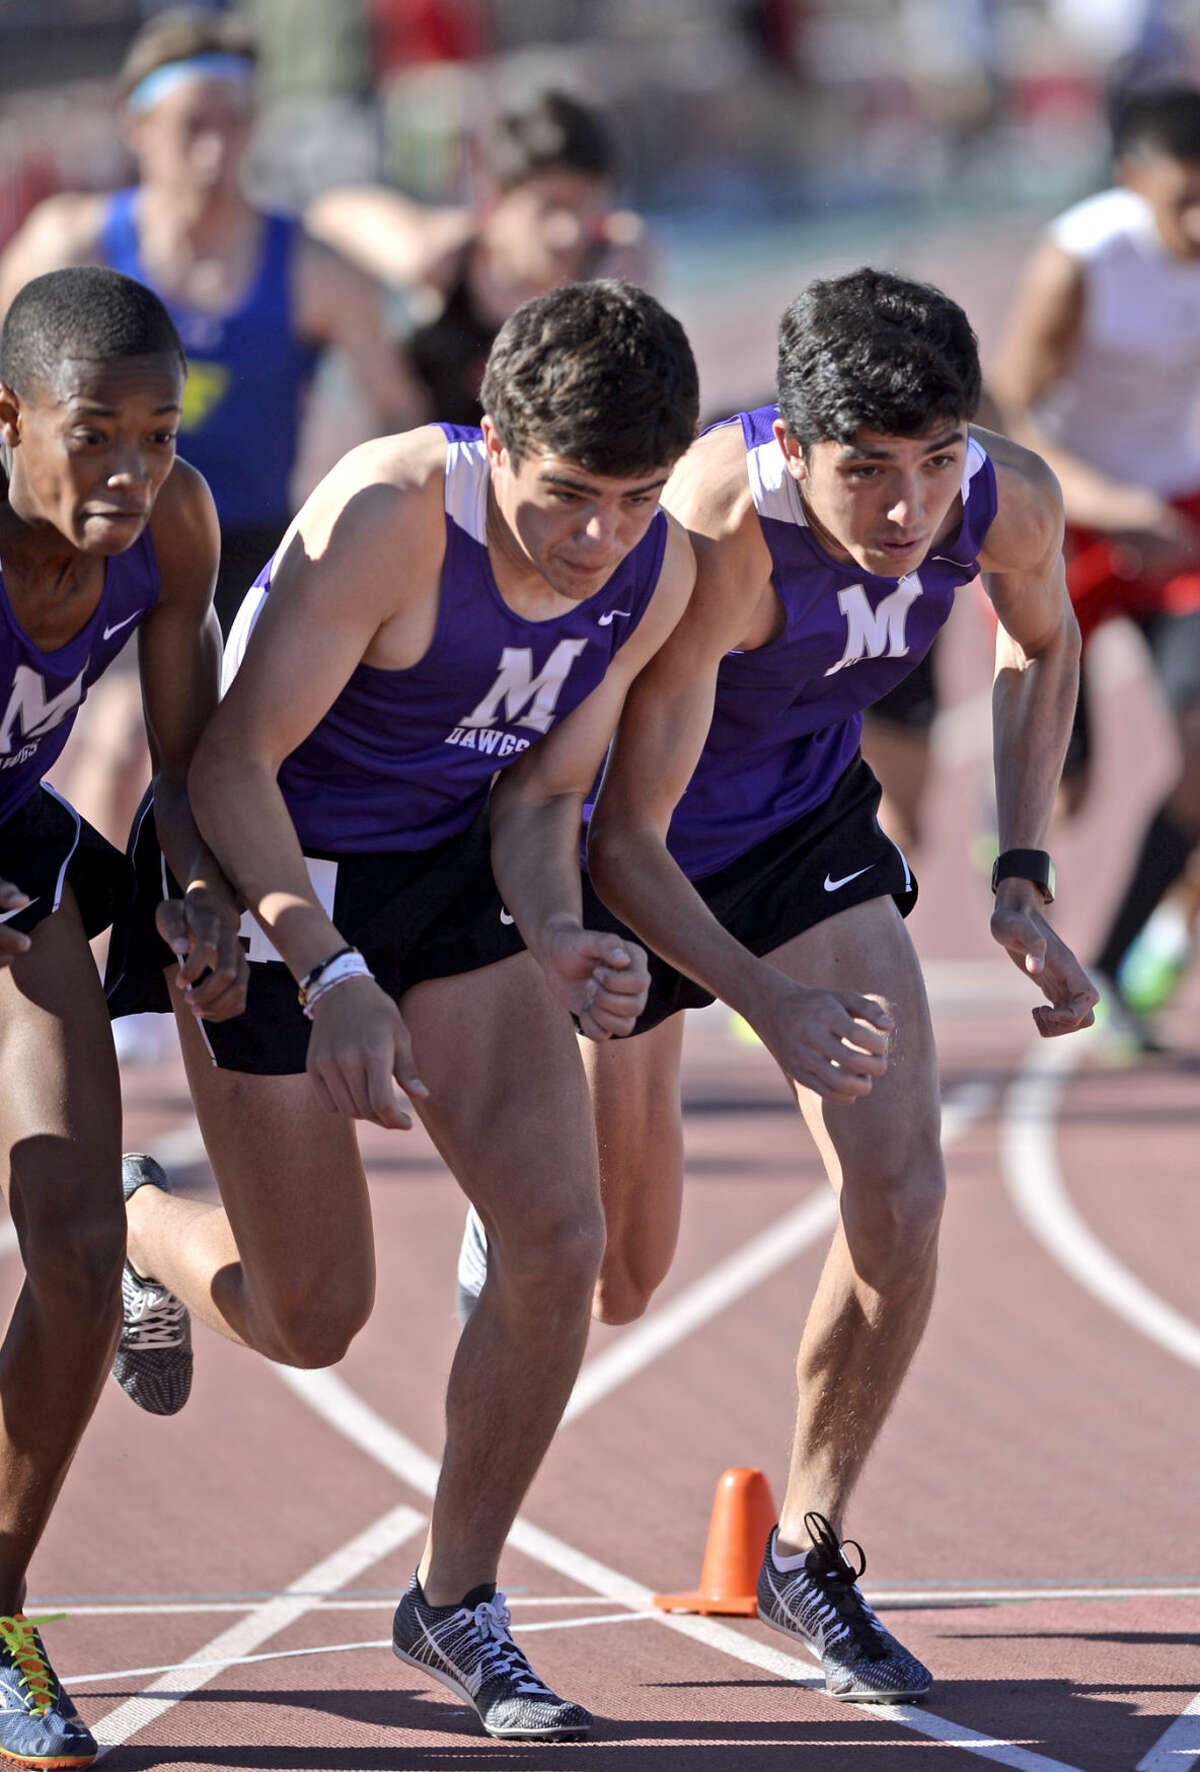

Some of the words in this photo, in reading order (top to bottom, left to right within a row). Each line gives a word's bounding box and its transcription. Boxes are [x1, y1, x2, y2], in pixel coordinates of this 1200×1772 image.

[823, 570, 924, 677] M
[0, 653, 91, 754] M
[457, 637, 589, 735] M
